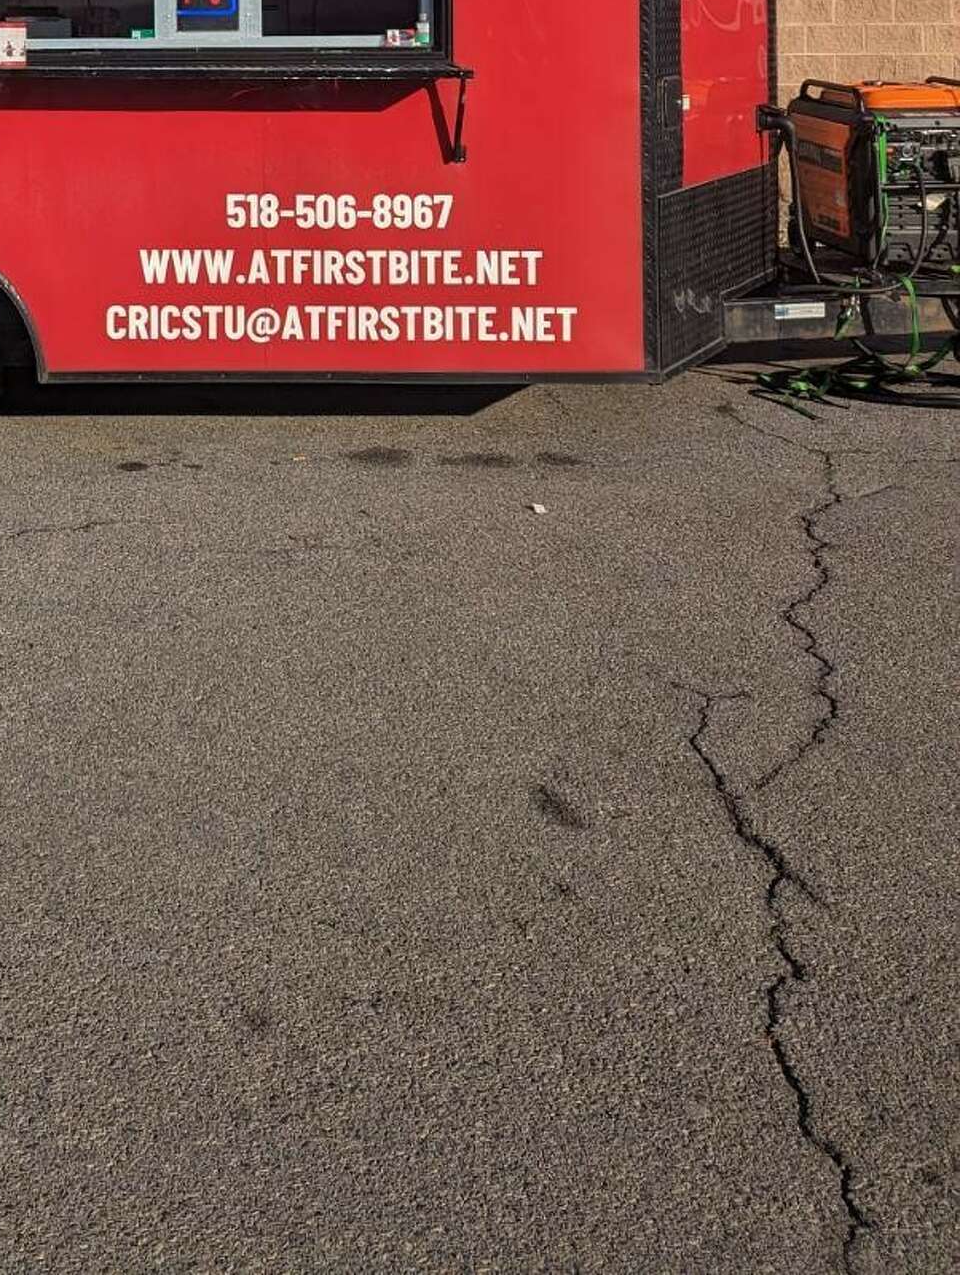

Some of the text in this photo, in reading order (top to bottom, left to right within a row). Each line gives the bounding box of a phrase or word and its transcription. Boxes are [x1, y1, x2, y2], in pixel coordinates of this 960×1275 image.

[226, 193, 454, 230] 518-506-8967
[139, 249, 543, 286] WWW.ATFIRSTBITE.NET
[105, 305, 578, 344] CRICSTU@ATFIRSTBITE.NET
